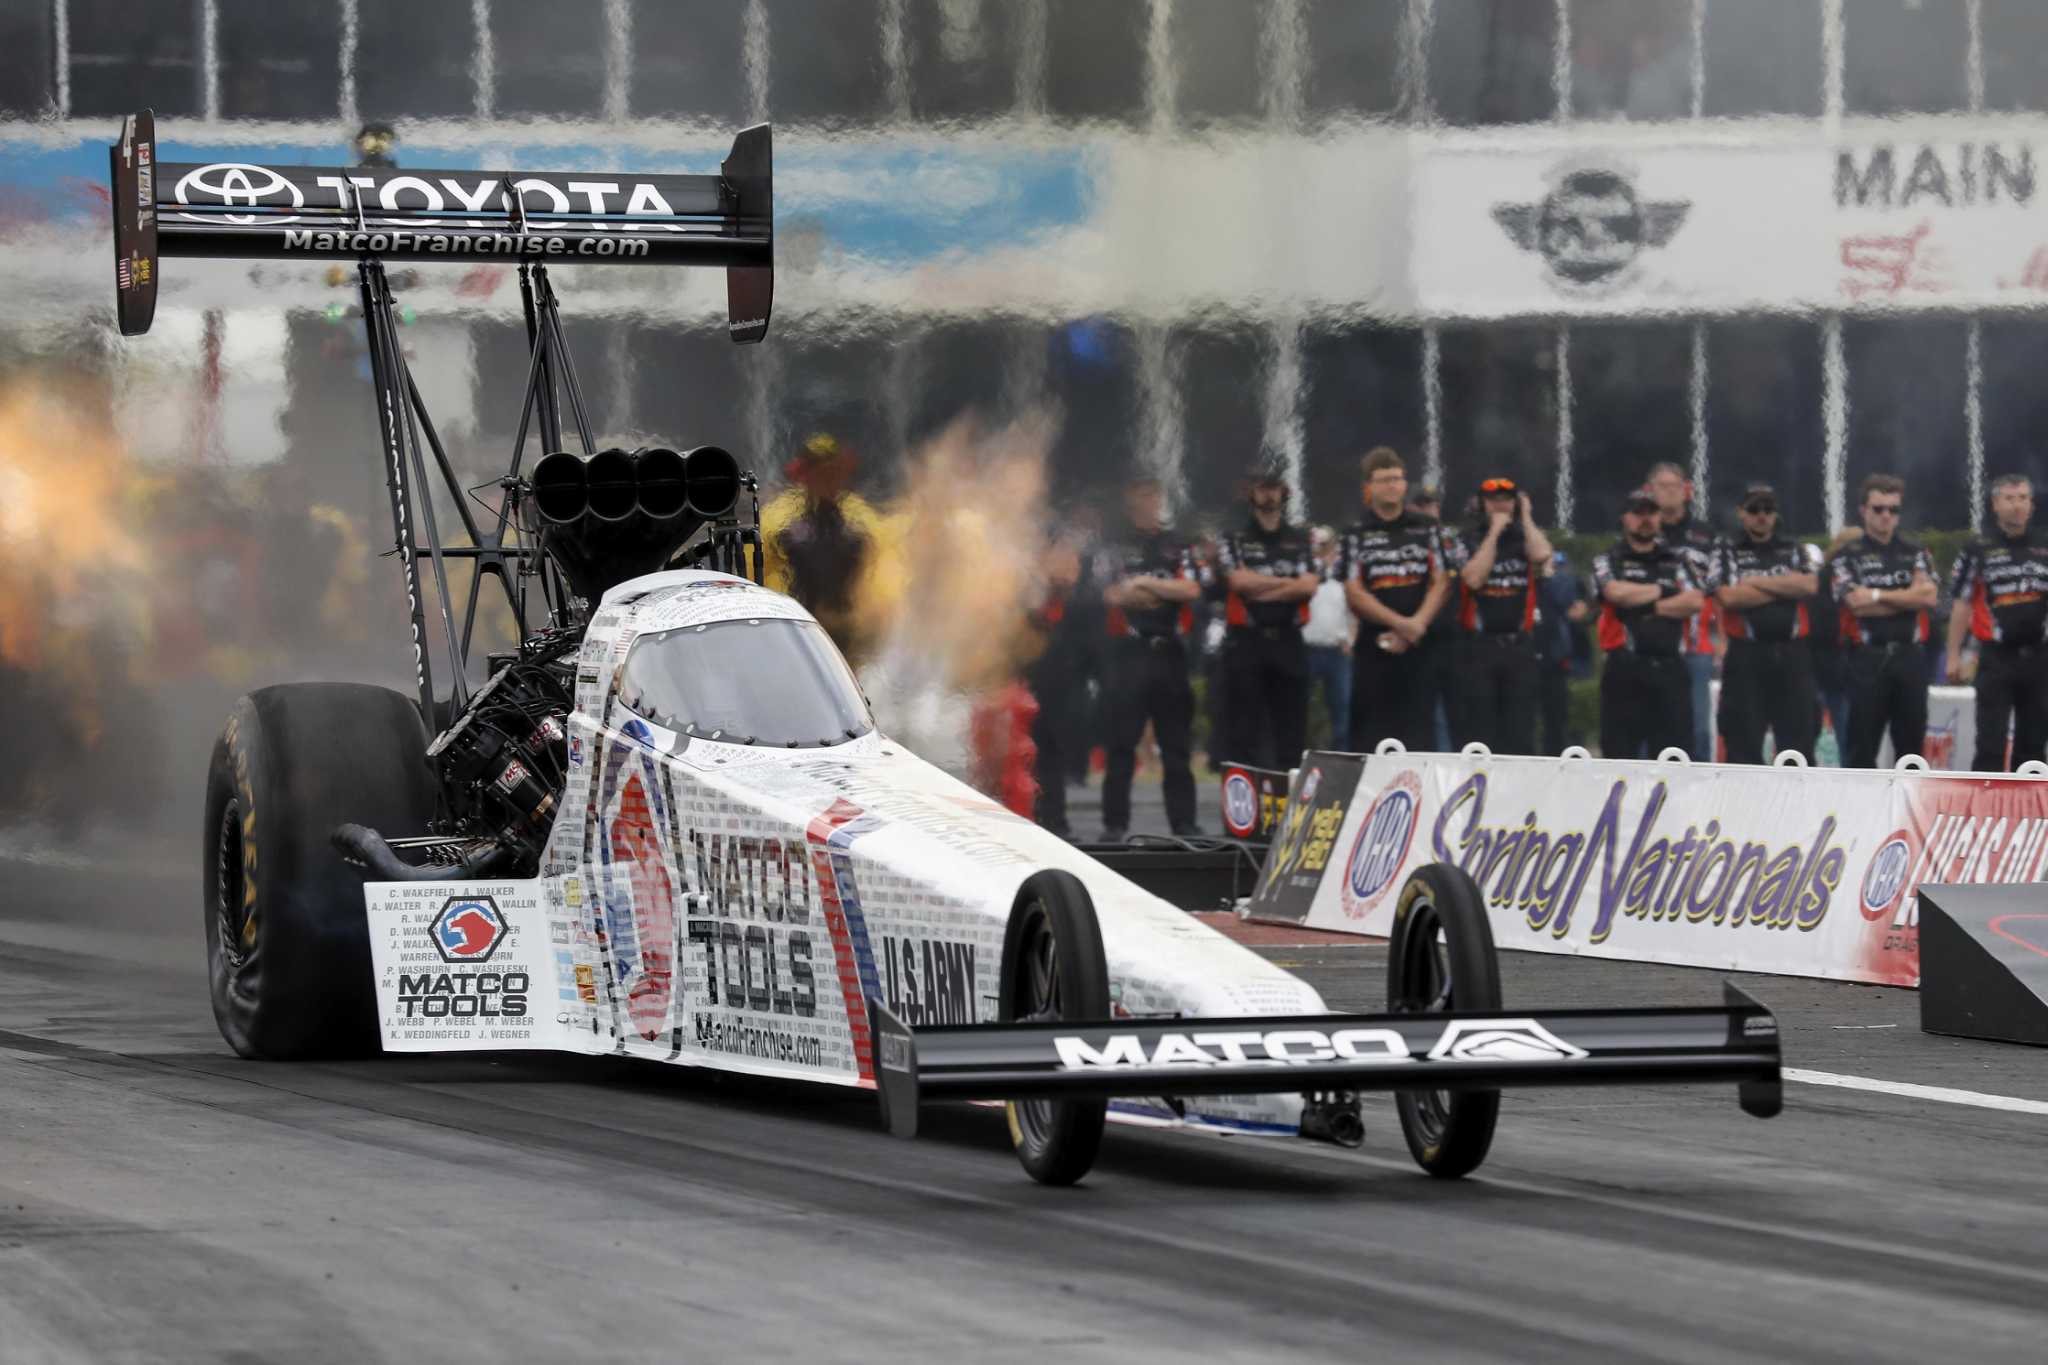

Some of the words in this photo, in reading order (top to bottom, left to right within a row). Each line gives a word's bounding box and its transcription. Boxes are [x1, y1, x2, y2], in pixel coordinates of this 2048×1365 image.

[317, 176, 687, 232] TOYOTA
[283, 229, 650, 257] MatcoFranchise.com
[695, 832, 810, 926] MATCO
[384, 902, 422, 911] WALTER
[688, 920, 817, 1018] TOOLS
[922, 939, 978, 1025] ARMY
[400, 973, 530, 996] MATCO
[397, 995, 528, 1018] TOOLS
[398, 1017, 425, 1026] WEBB
[501, 1016, 535, 1026] WEBER
[491, 1030, 531, 1039] WEGNER
[1053, 1028, 1412, 1070] MATCO
